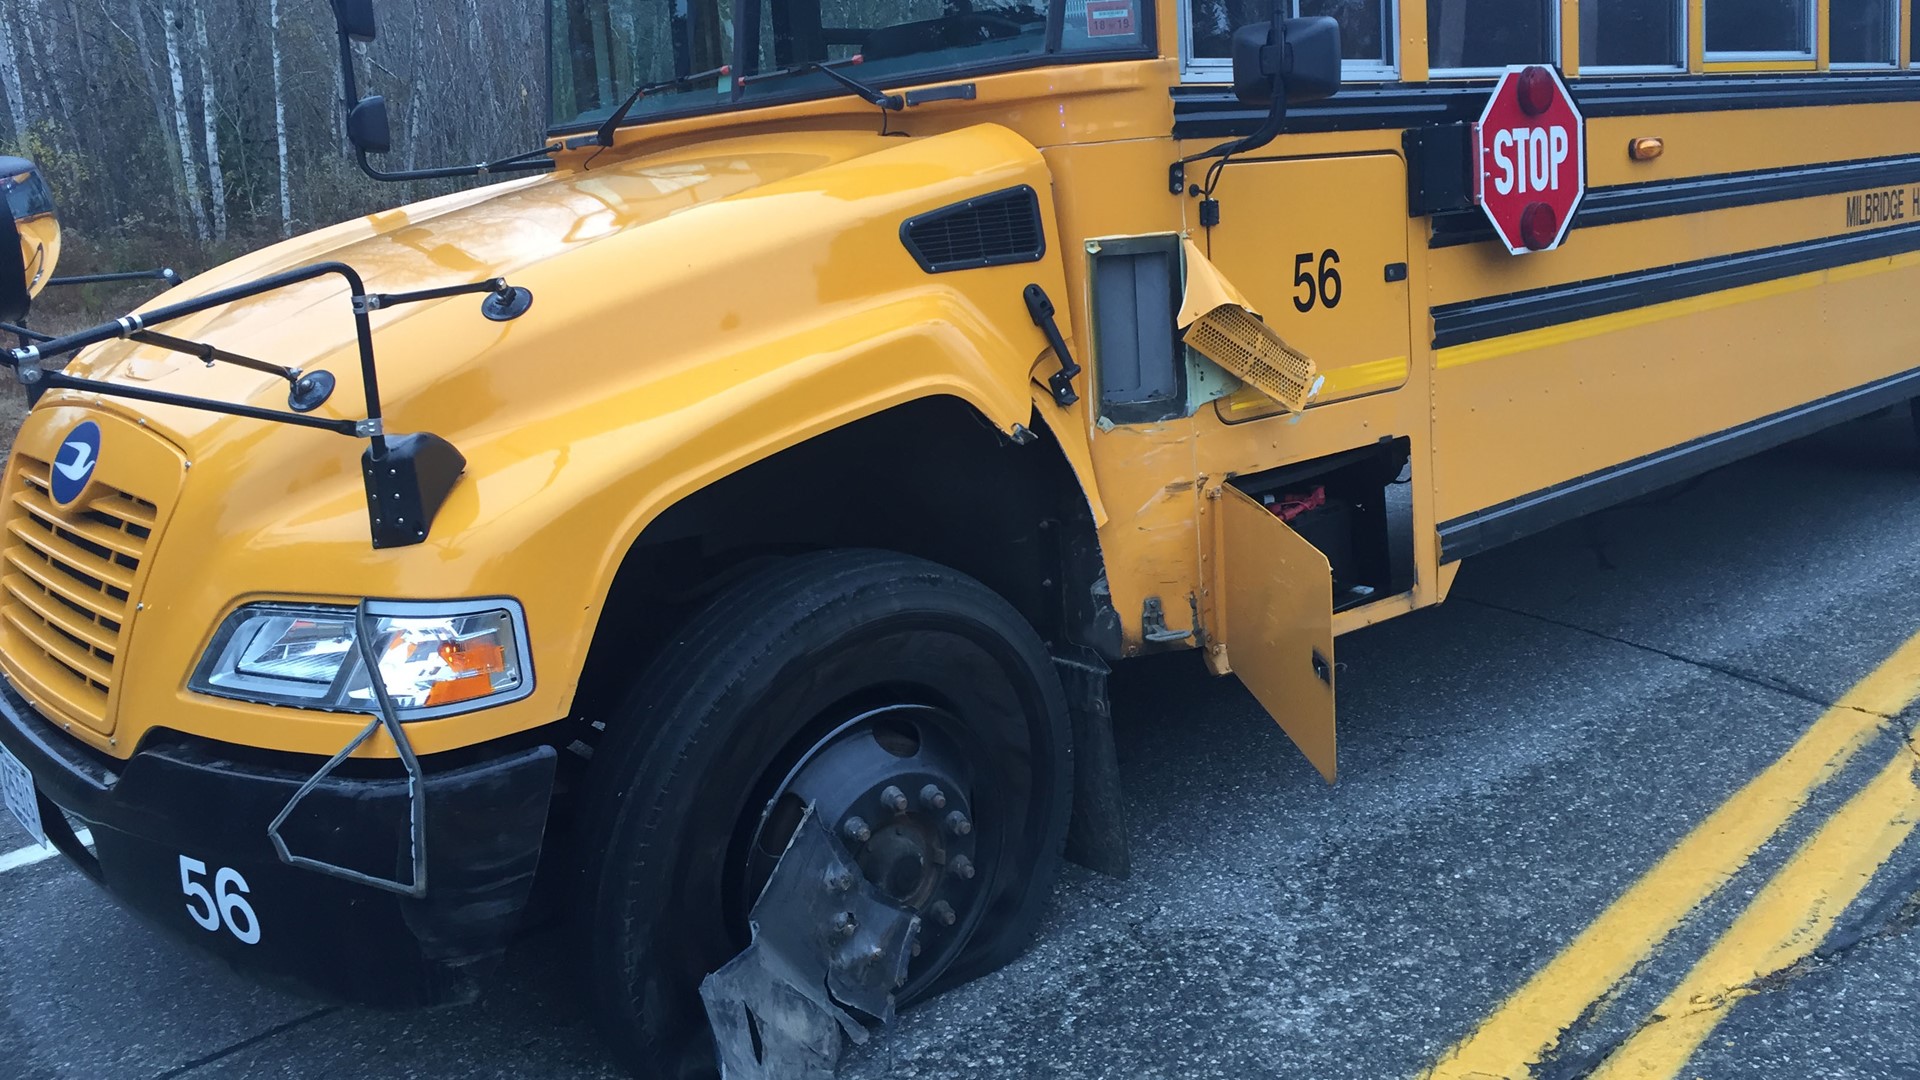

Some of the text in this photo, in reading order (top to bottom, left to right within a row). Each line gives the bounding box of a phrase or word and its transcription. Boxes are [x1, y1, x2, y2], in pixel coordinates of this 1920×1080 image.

[1494, 125, 1568, 195] STOP
[1846, 189, 1904, 227] MILBRIDGE
[1293, 248, 1342, 313] 56
[179, 854, 260, 945] 56
